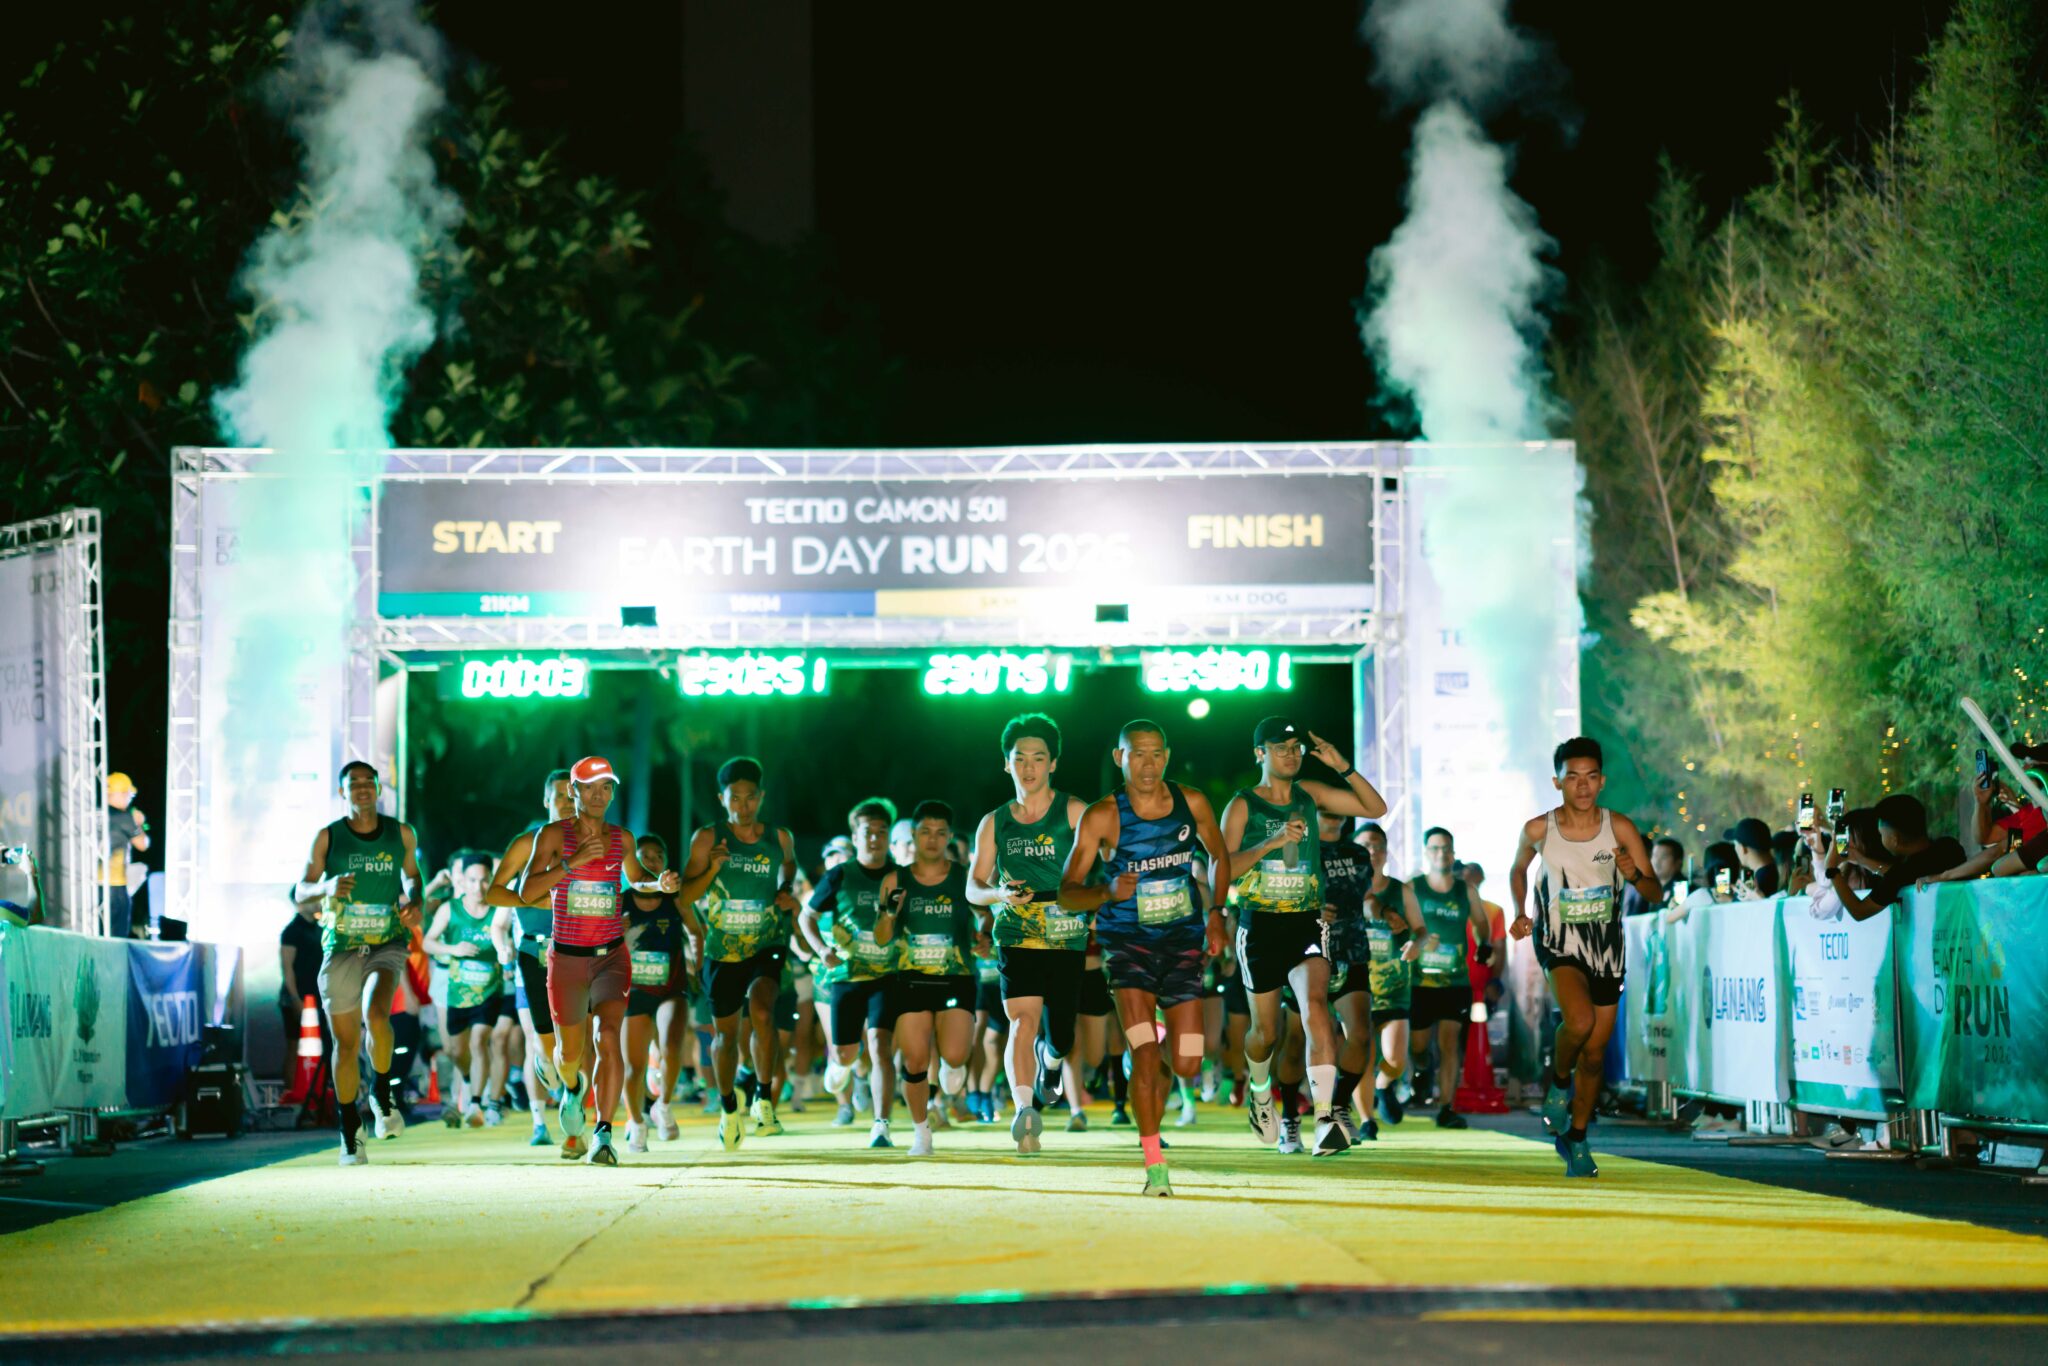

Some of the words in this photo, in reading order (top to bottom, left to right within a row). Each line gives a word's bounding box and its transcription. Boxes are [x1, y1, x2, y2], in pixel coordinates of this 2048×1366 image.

[744, 497, 846, 524] TECNO
[855, 497, 960, 524] CAMON
[432, 521, 562, 553] START
[1188, 514, 1323, 548] FINISH
[617, 537, 776, 576] EARTH
[793, 535, 891, 575] DAY
[901, 534, 1008, 574] RUN
[1018, 533, 1135, 573] 2026
[479, 594, 531, 613] 21KM
[1246, 591, 1288, 605] DOG
[1007, 839, 1035, 849] EARTH
[1007, 847, 1022, 856] DAY
[1024, 844, 1055, 857] RUN
[348, 862, 363, 870] DAY
[365, 862, 393, 872] RUN
[744, 863, 770, 874] RUN
[1325, 857, 1353, 869] PNW
[1327, 867, 1357, 878] DGN
[1268, 876, 1304, 888] 23075
[574, 897, 613, 909] 23469
[1144, 892, 1184, 912] 23500
[1567, 901, 1606, 916] 23465
[925, 905, 952, 914] RUN
[350, 918, 385, 929] 23284
[1819, 932, 1849, 960] TECNO
[914, 948, 947, 960] 23227
[1715, 977, 1766, 1023] LANANG
[1954, 984, 2011, 1038] RUN
[141, 991, 198, 1047] TECNO
